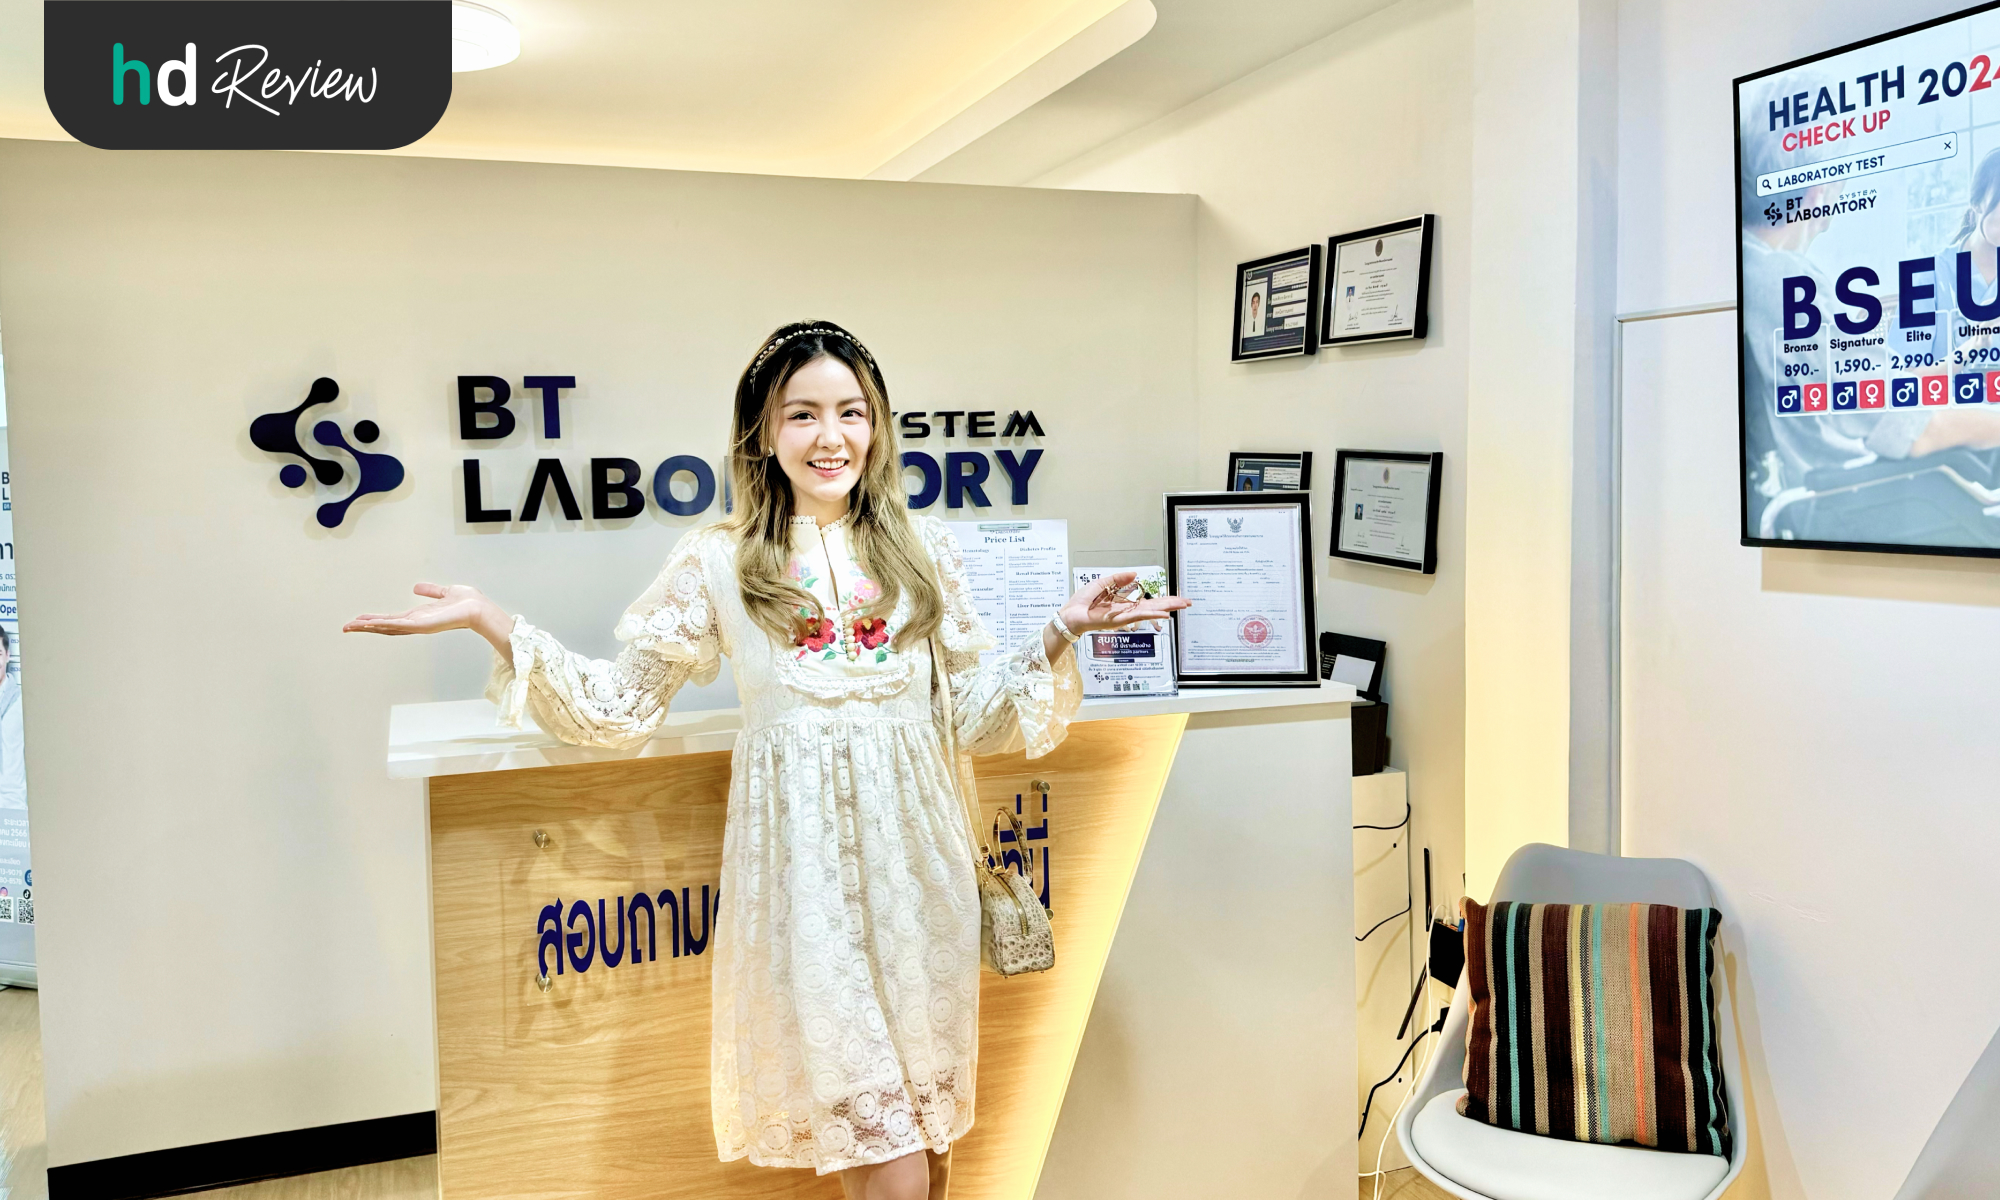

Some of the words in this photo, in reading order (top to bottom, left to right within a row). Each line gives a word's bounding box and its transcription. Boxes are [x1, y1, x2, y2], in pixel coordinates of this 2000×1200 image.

[1769, 65, 1905, 131] HEALTH
[1917, 54, 2000, 105] 202
[1782, 117, 1856, 152] CHECK
[1862, 109, 1891, 133] UP
[1778, 162, 1853, 188] LABORATORY
[1856, 155, 1885, 171] TEST
[1786, 196, 1803, 211] BT
[1839, 188, 1877, 200] SYSTEM
[1786, 195, 1878, 224] LABORATORY
[1783, 342, 1819, 353] Bronze
[1829, 336, 1885, 351] Signature
[1906, 330, 1932, 342] Elite
[1784, 363, 1819, 377] 890.-
[1834, 358, 1881, 375] 1,590.-
[1891, 352, 1945, 371] 2,990.-
[458, 375, 576, 439] BT
[892, 410, 1045, 438] STEM
[1097, 636, 1130, 646] สุขภาพ
[537, 885, 720, 978] สอบถาม
